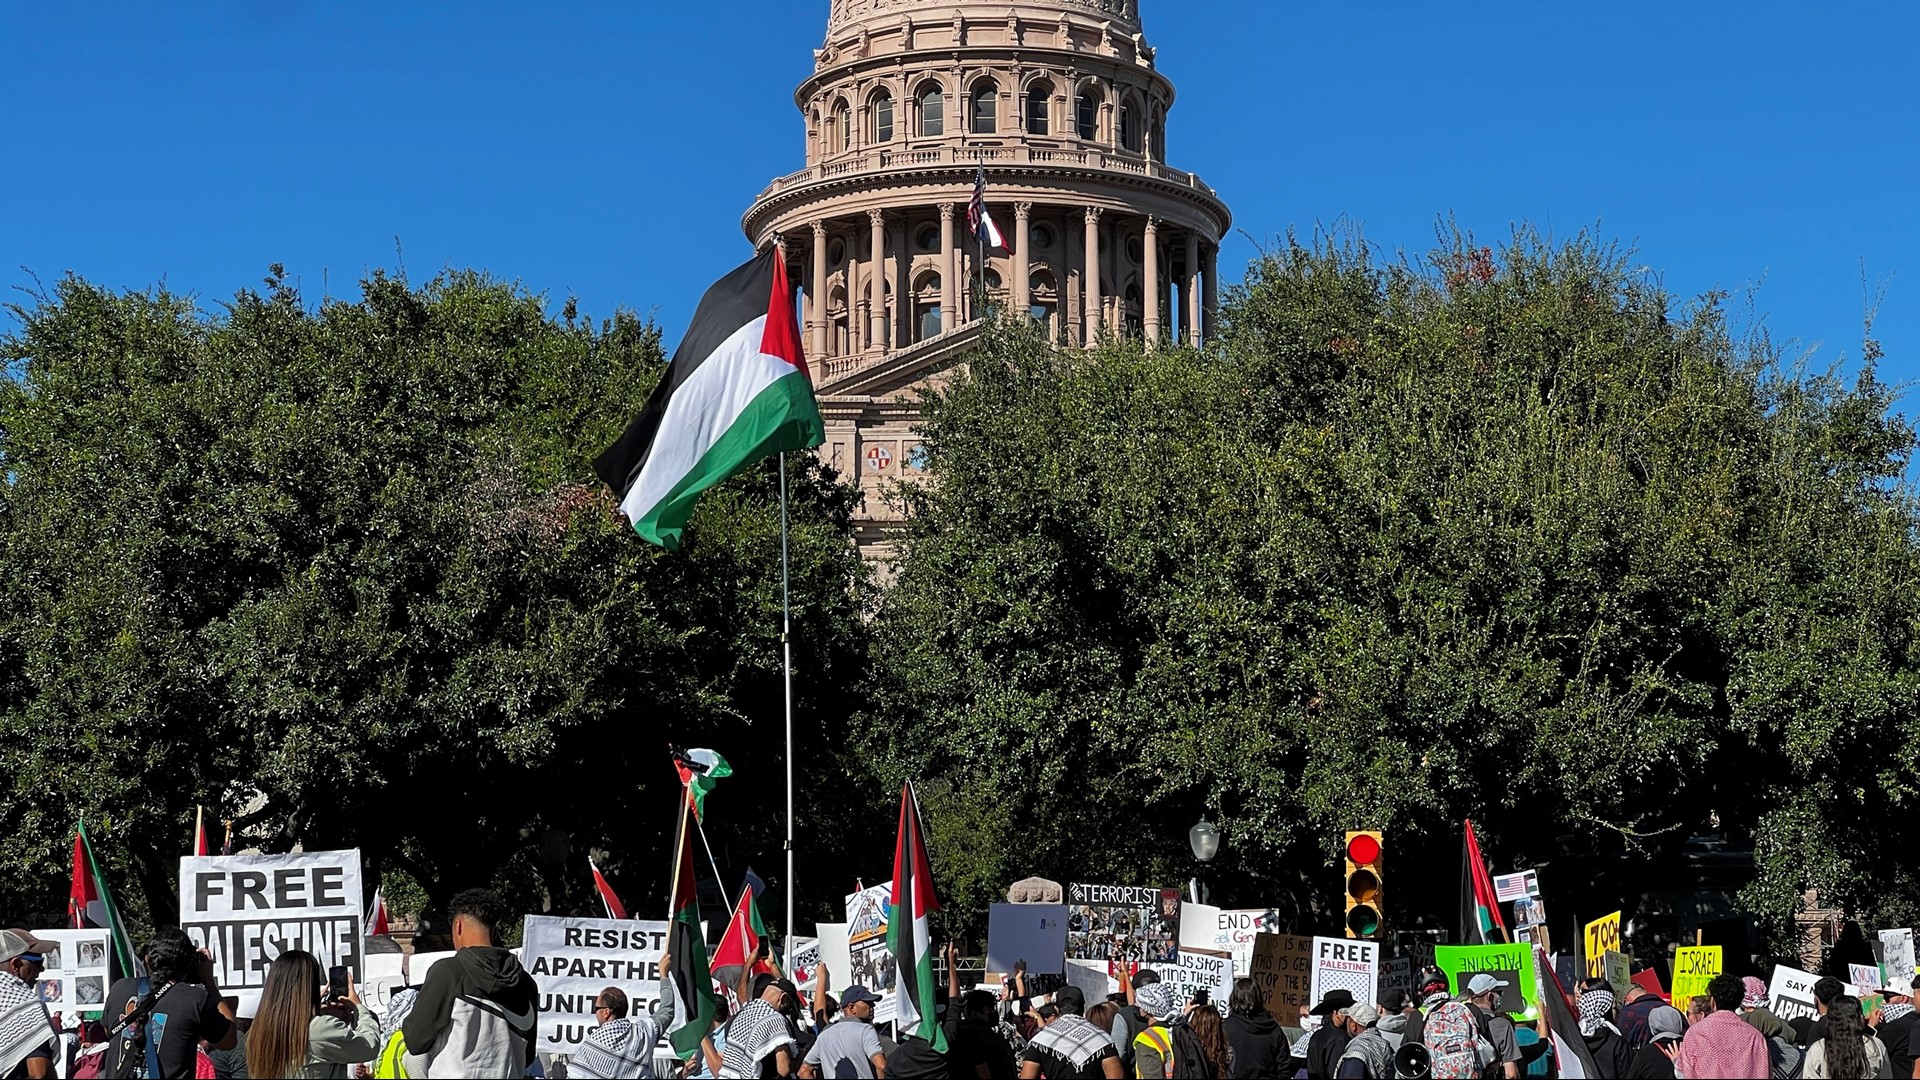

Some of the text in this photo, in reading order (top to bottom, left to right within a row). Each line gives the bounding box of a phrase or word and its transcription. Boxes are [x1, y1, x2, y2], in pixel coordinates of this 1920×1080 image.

[195, 867, 345, 911] FREE
[1070, 883, 1161, 905] THE TERRORIST
[1218, 914, 1251, 930] END
[565, 928, 667, 950] RESIST
[1285, 938, 1293, 951] IS
[1320, 942, 1371, 963] FREE
[1256, 954, 1274, 969] THIS
[1278, 956, 1288, 971] IS
[1320, 960, 1370, 973] PALESTINE!
[1459, 952, 1523, 972] PALESTINE
[1680, 951, 1720, 975] ISRAEL
[1191, 971, 1221, 987] THERE
[1284, 974, 1298, 990] THE
[1851, 965, 1877, 984] KNOW
[155, 982, 172, 999] SONY
[1786, 980, 1807, 992] SAY
[1281, 993, 1298, 1007] THE
[112, 1021, 127, 1035] SONY
